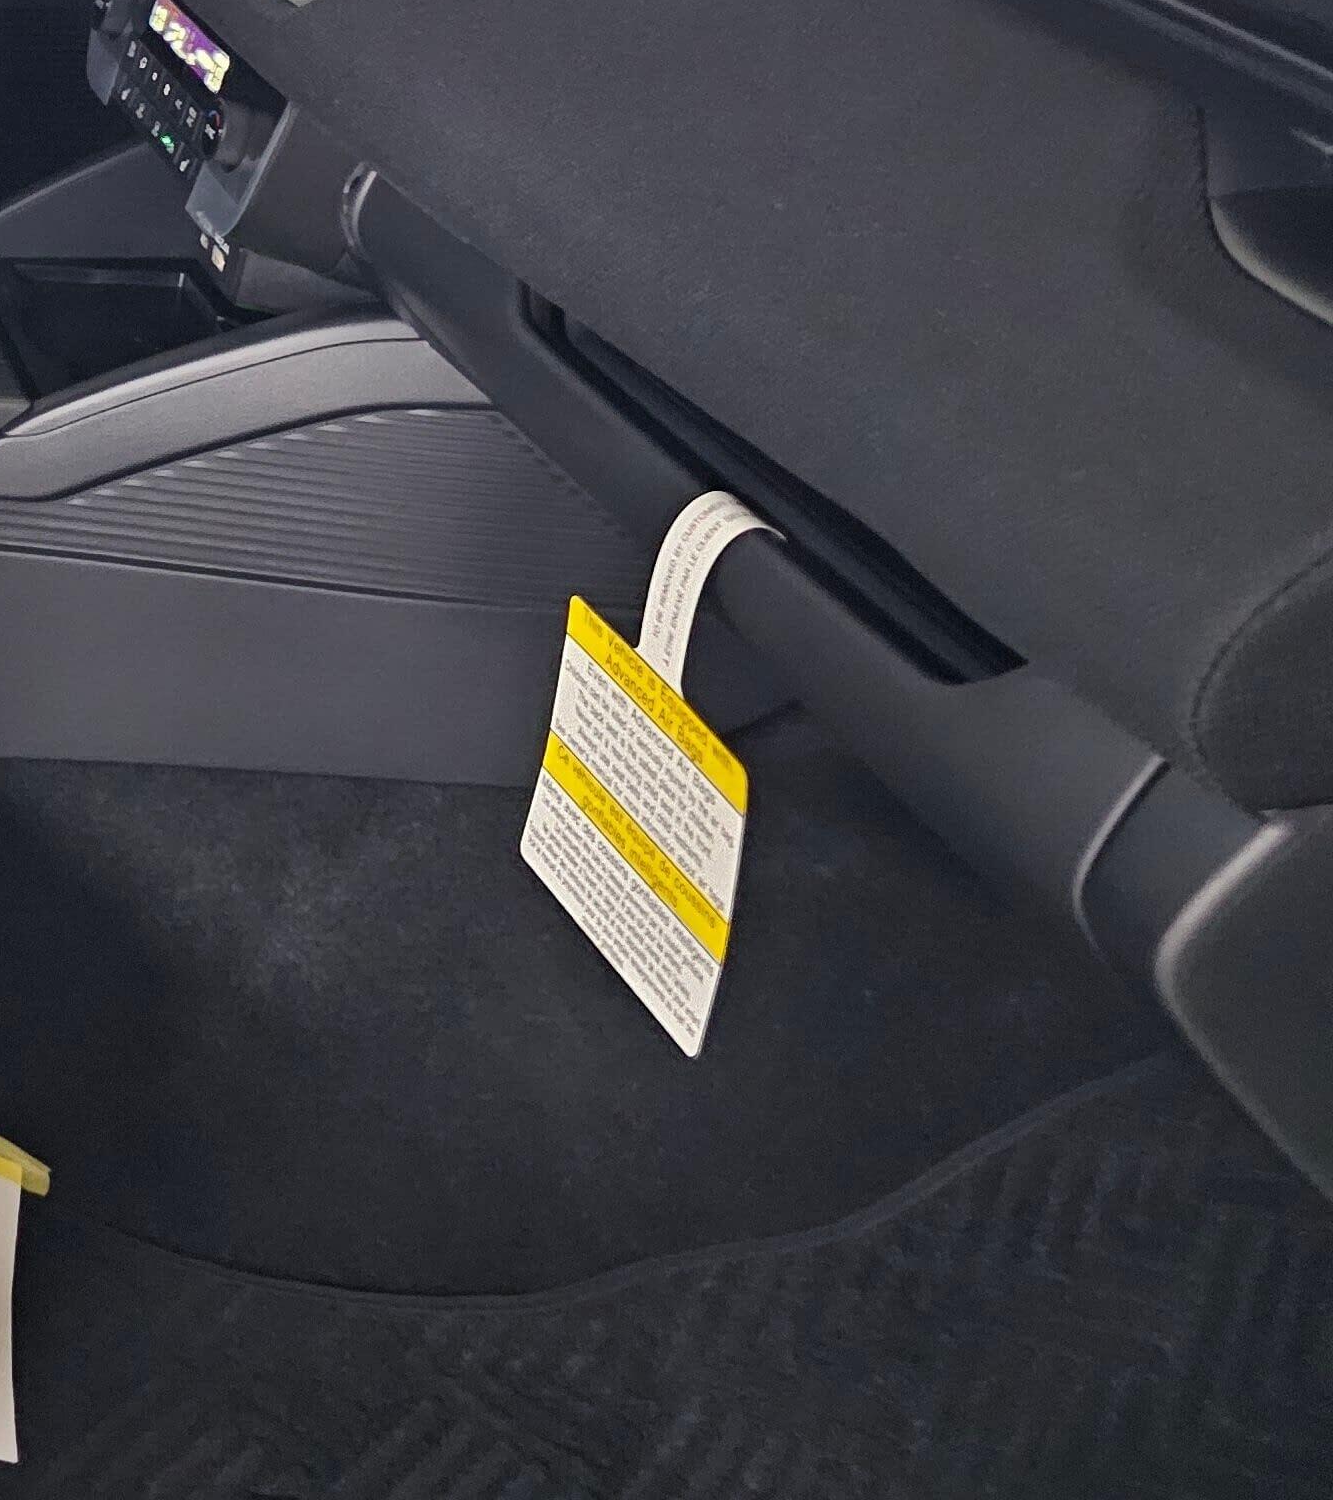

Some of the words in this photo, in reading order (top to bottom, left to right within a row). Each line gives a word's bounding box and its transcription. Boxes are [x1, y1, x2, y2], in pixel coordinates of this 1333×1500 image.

[604, 651, 655, 713] Advanced
[658, 705, 673, 731] Air
[675, 723, 704, 769] Bags
[606, 633, 643, 678] Vehicle
[586, 661, 608, 692] Even
[630, 706, 674, 761] Advanced
[691, 770, 716, 810] Bags
